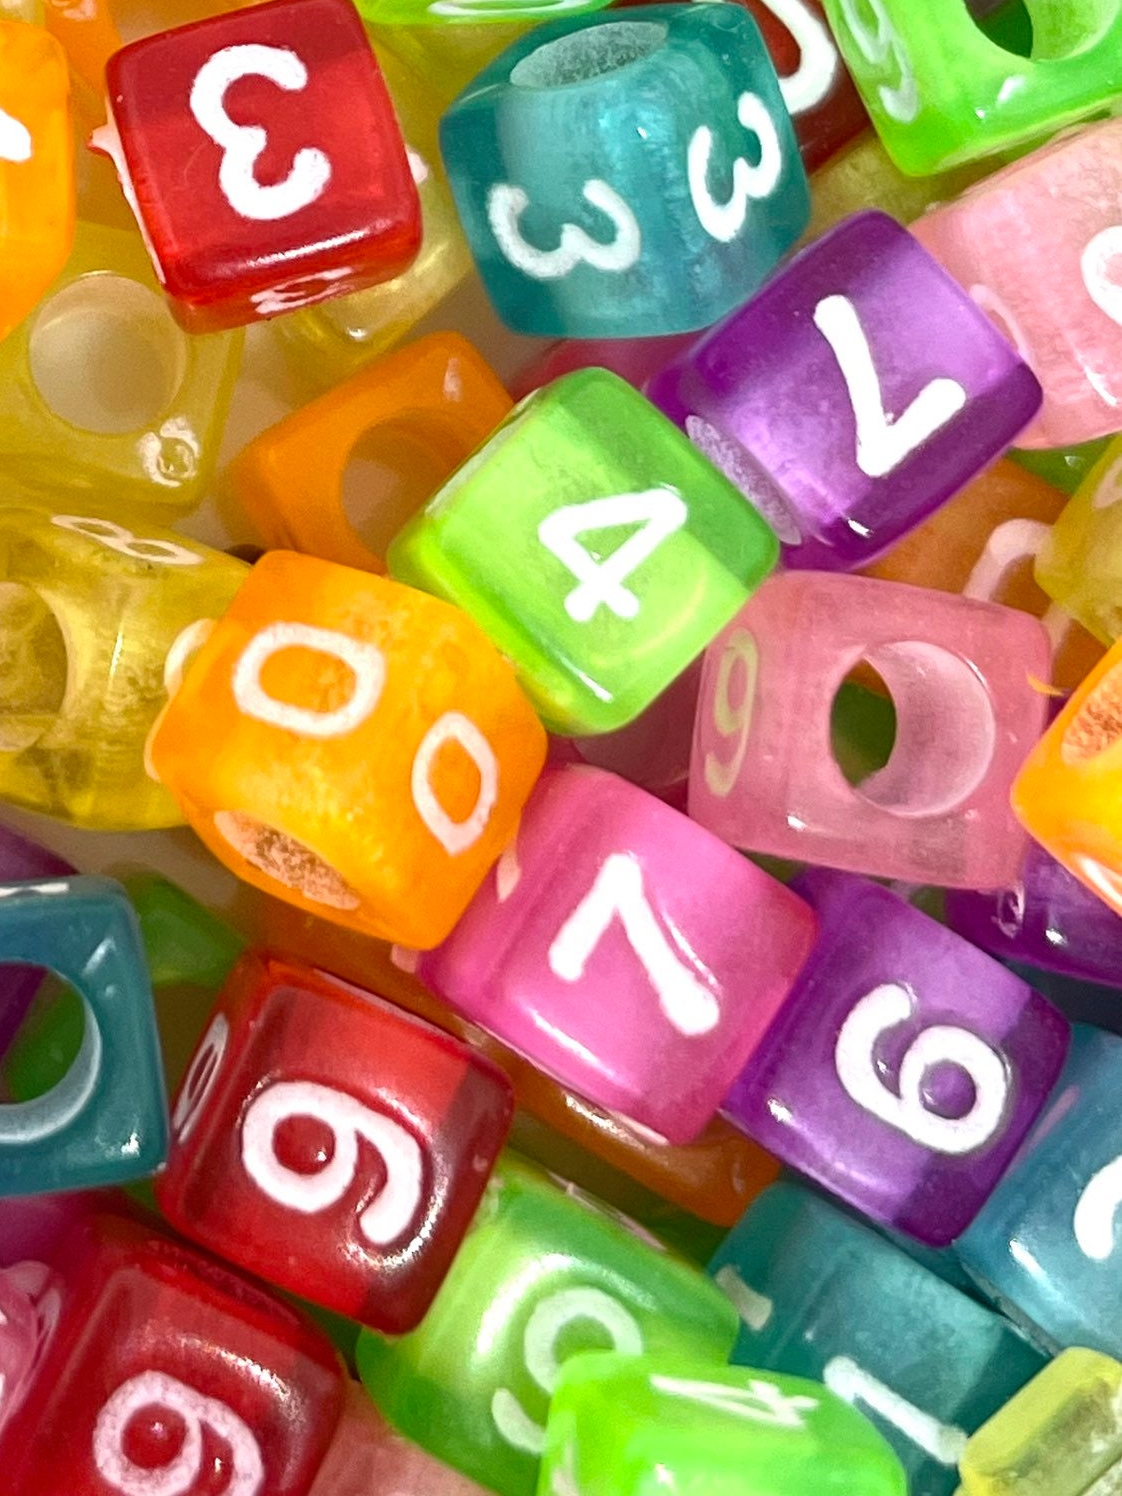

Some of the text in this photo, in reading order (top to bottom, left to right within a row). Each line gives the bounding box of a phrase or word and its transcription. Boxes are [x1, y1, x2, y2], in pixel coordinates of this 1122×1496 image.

[190, 44, 331, 221] 3
[688, 91, 782, 243] 3
[488, 180, 642, 280] 3
[813, 294, 967, 477] 7
[538, 486, 688, 622] 4
[233, 621, 387, 737] 0
[412, 711, 499, 857] 0
[549, 853, 721, 1036] 7
[834, 982, 1009, 1155] 6
[242, 1080, 424, 1246] 9
